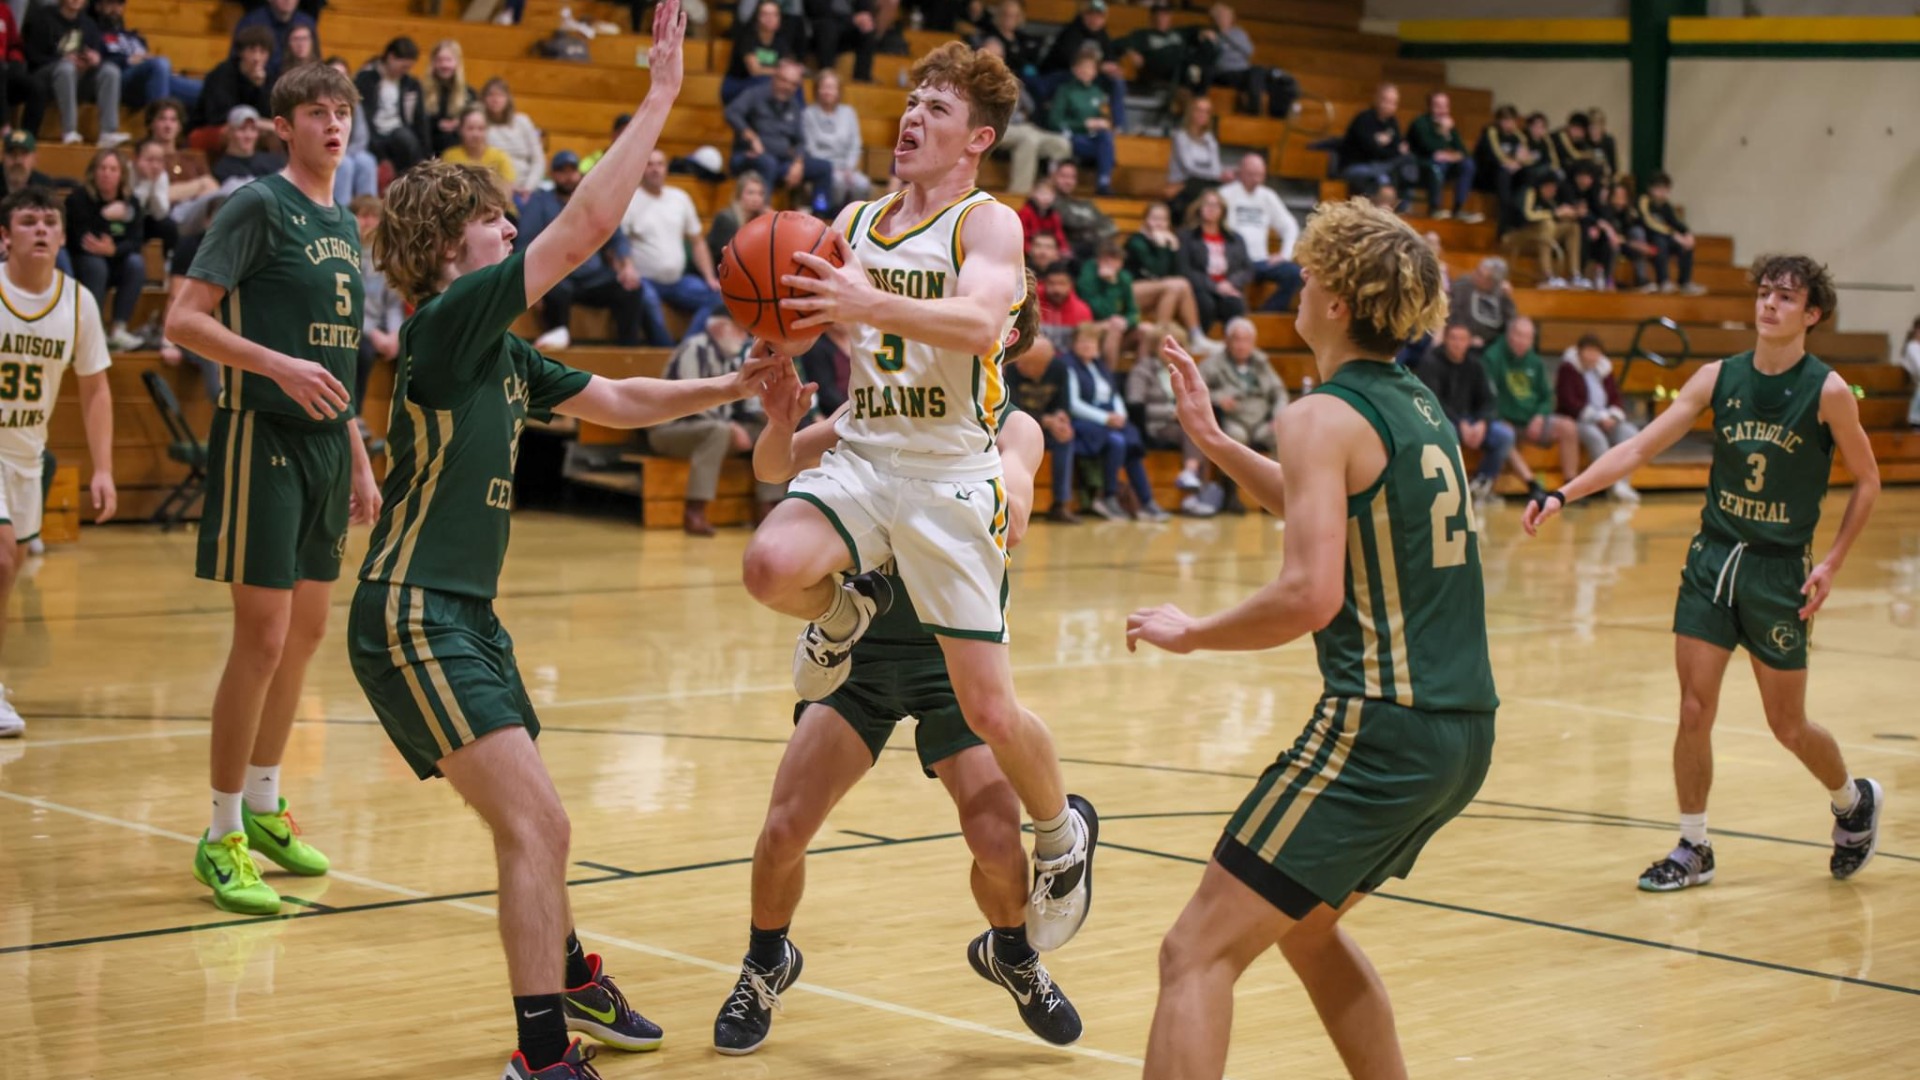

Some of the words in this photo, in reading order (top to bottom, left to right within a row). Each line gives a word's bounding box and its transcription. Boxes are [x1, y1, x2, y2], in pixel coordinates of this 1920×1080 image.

[335, 272, 352, 316] 5
[867, 267, 947, 300] DISON
[0, 332, 66, 360] ADISON
[0, 362, 43, 402] 35
[0, 408, 44, 428] LAINS
[854, 385, 946, 419] PLAINS
[1722, 421, 1803, 454] CATHOLIC
[1744, 453, 1767, 493] 3
[1719, 490, 1790, 523] CENTRAL
